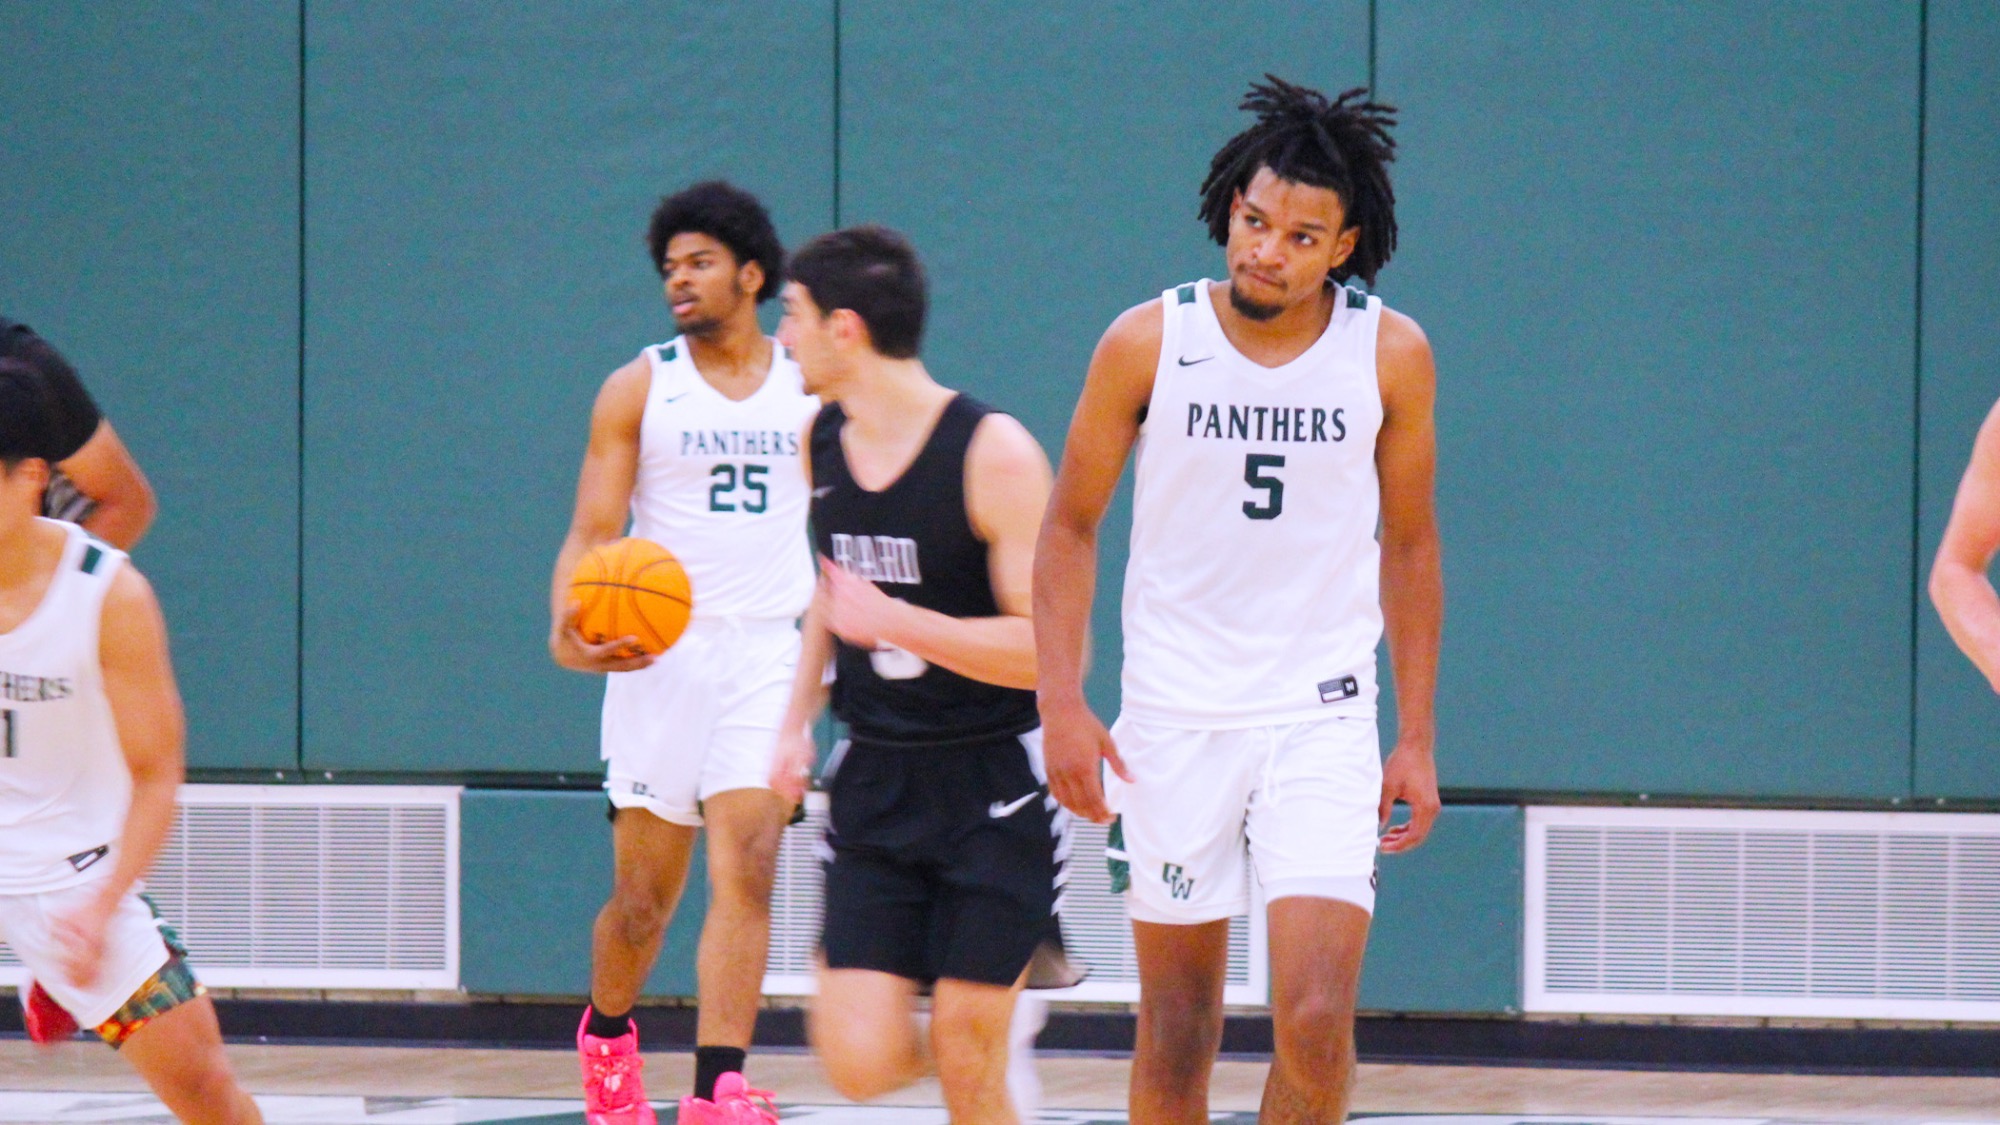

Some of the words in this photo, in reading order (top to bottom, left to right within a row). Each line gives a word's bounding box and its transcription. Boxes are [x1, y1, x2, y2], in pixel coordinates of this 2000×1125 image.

[680, 429, 799, 456] PANTHERS
[1187, 402, 1346, 443] PANTHERS
[709, 463, 769, 514] 25
[1242, 453, 1286, 520] 5
